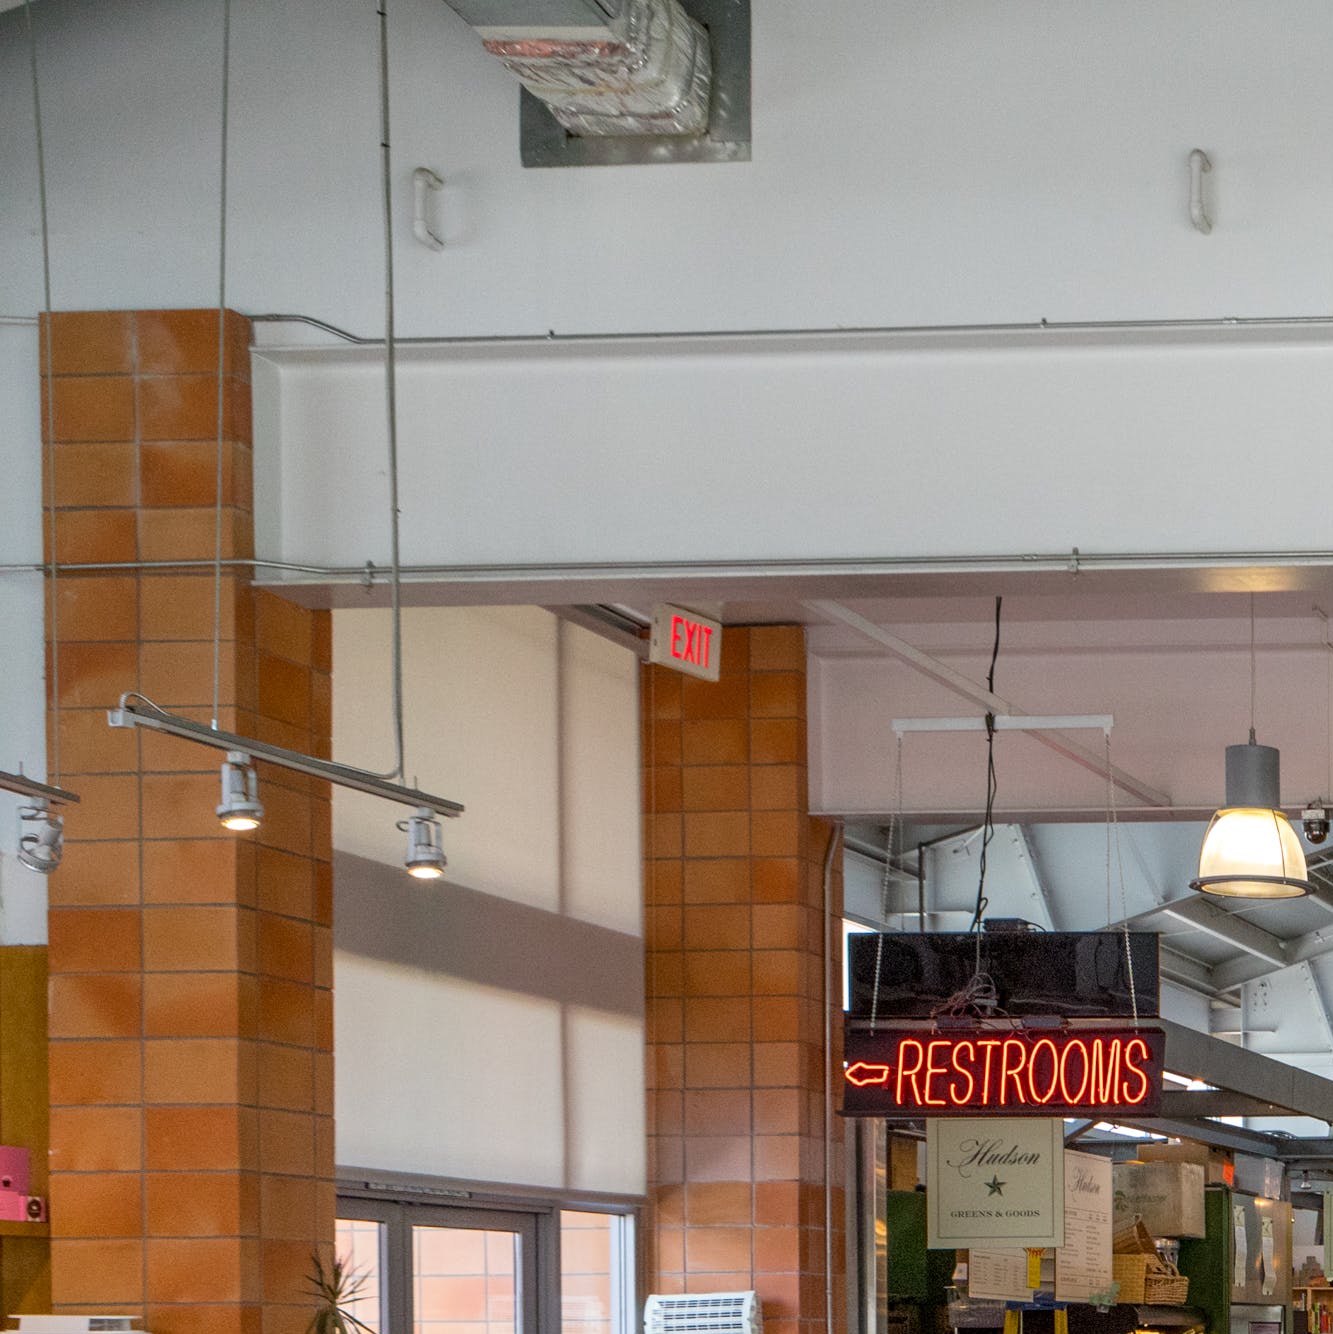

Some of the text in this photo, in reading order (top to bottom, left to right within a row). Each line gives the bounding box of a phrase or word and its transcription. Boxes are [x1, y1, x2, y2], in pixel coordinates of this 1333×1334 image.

[671, 614, 713, 669] EXIT
[896, 1038, 1149, 1105] RESTROOMS
[946, 1138, 1041, 1179] Hudson
[950, 1209, 1041, 1218] GREENS & GOODS
